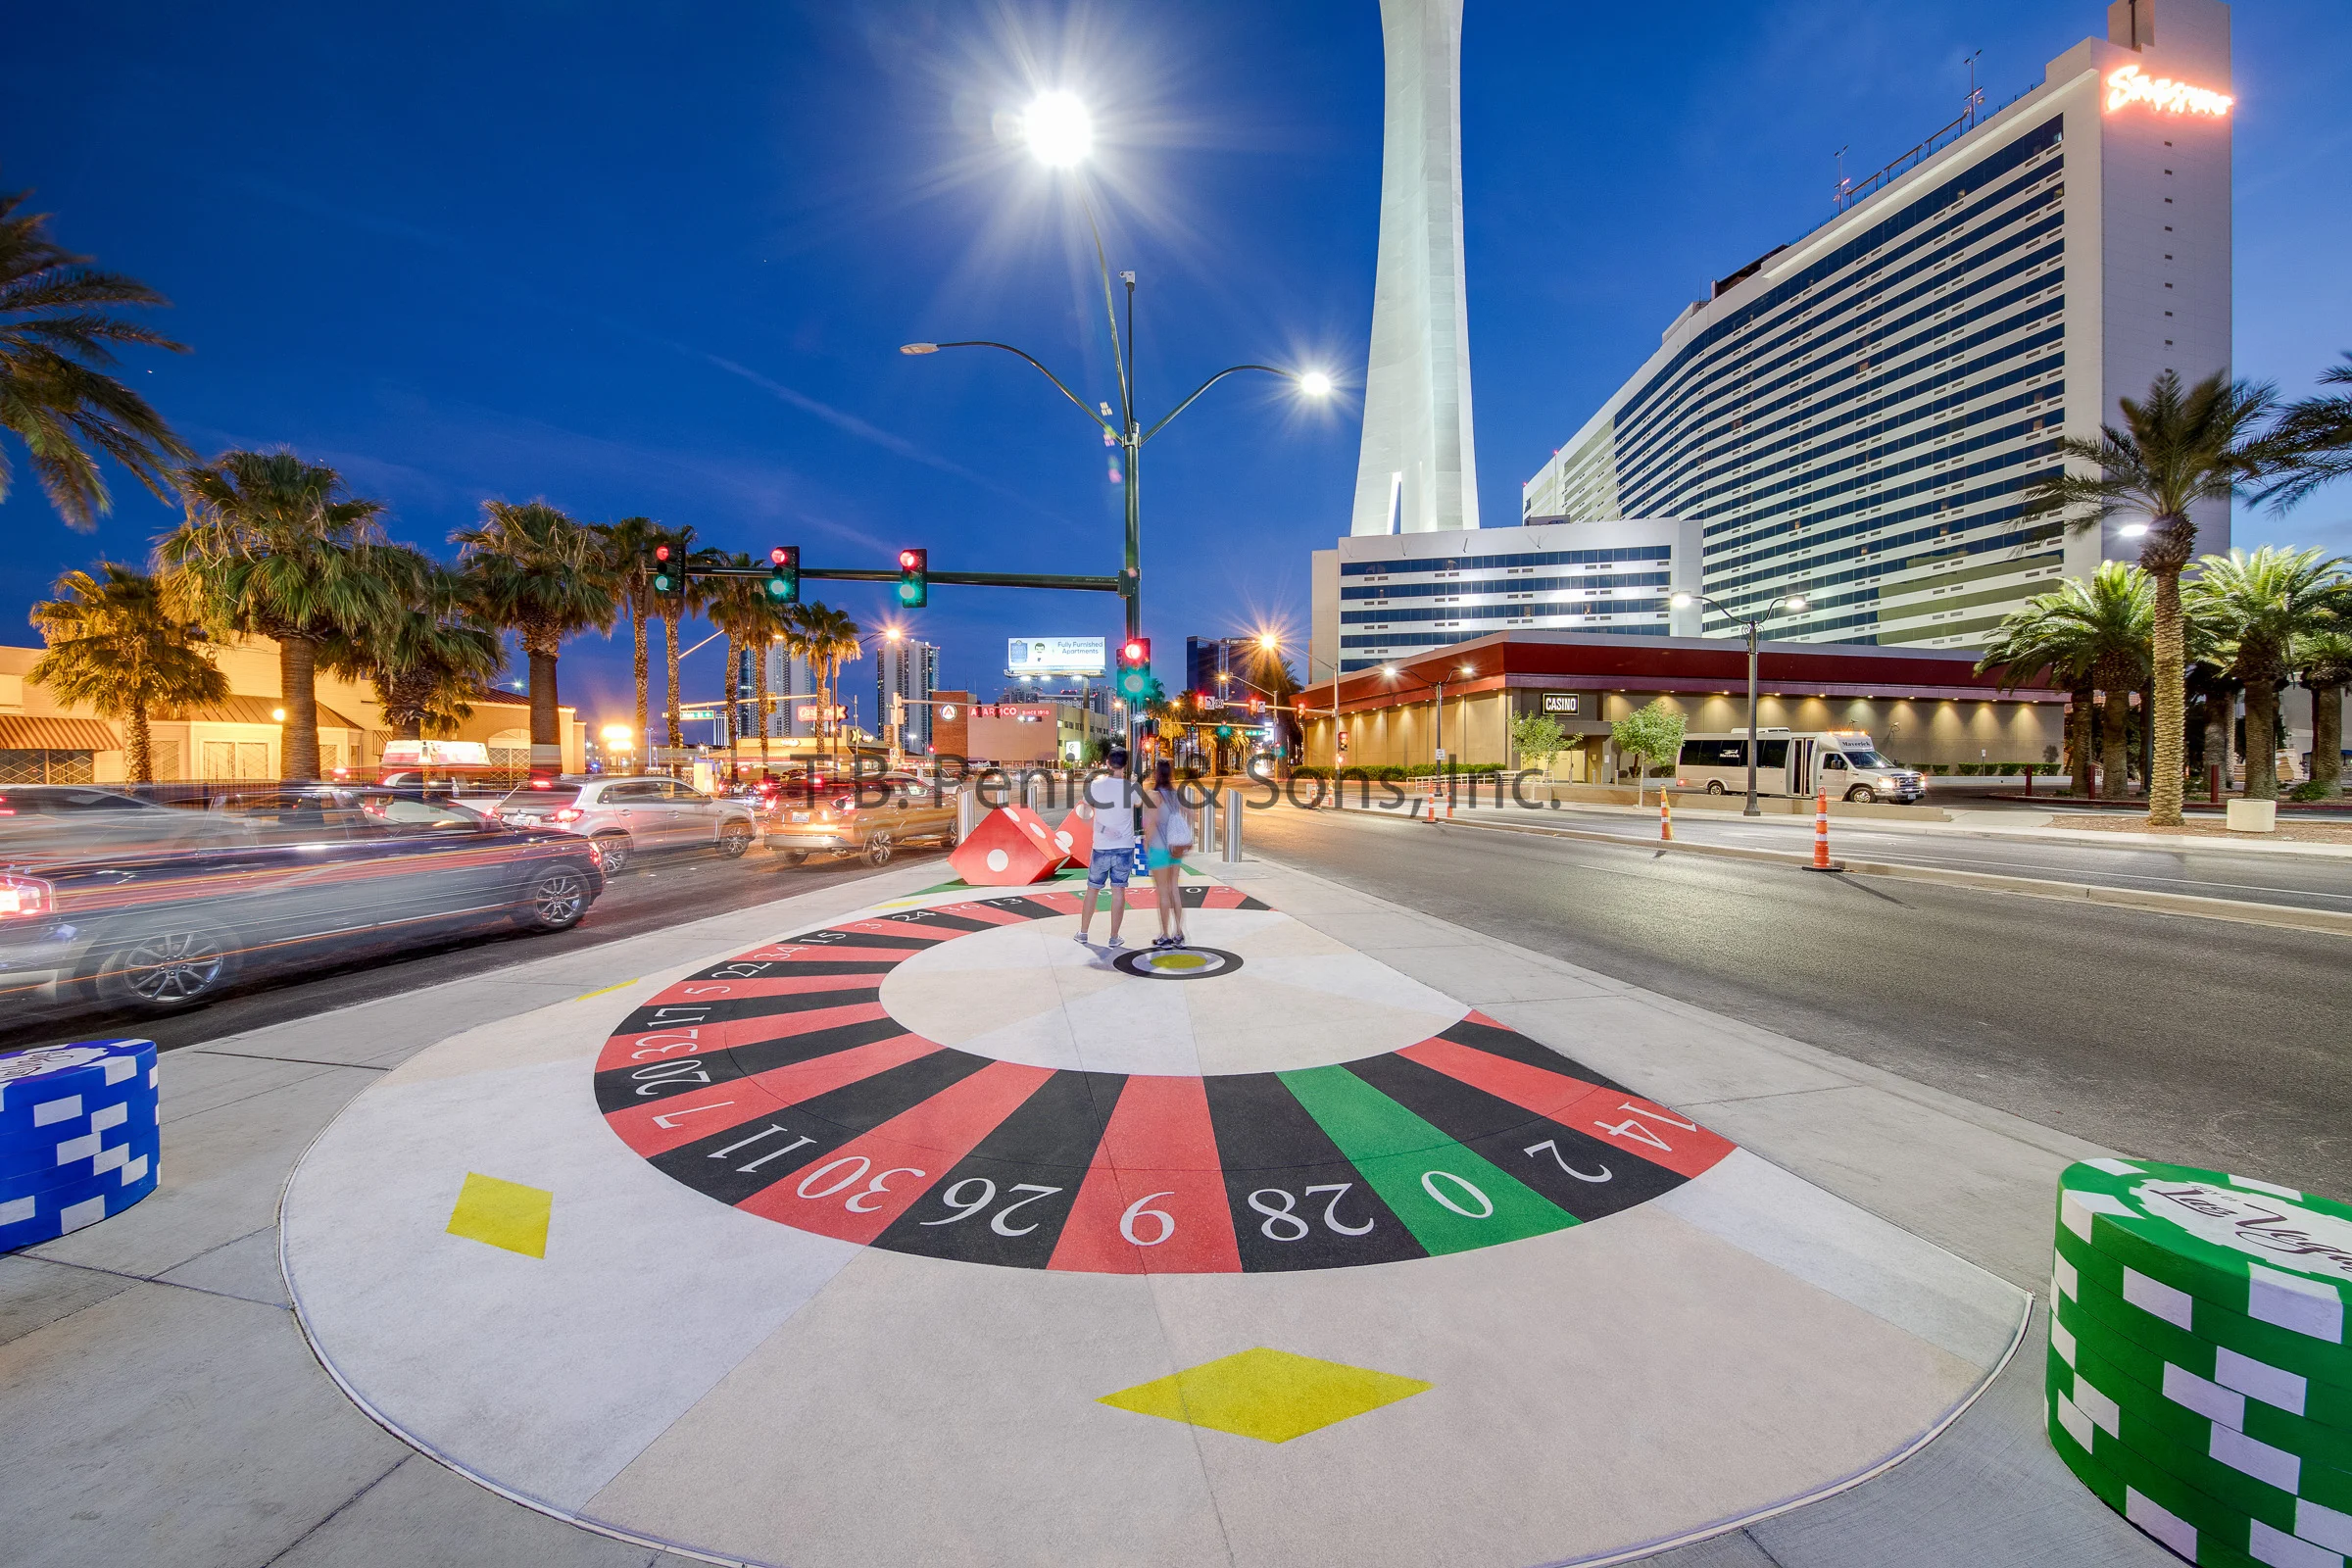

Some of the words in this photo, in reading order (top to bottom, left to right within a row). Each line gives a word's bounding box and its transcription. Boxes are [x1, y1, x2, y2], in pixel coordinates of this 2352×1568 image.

[970, 707, 1017, 716] AARCO
[1545, 698, 1577, 711] CASINO
[892, 908, 937, 922] 24
[939, 903, 980, 912] 36
[987, 898, 1023, 906] 13
[753, 944, 808, 959] 34
[799, 932, 847, 944] 15
[710, 961, 773, 979] 22
[683, 985, 731, 995] 5
[647, 1006, 711, 1027] 17
[630, 1029, 699, 1059] 32
[631, 1059, 711, 1096] 20
[652, 1101, 735, 1129] 7
[1593, 1102, 1698, 1152] 14
[707, 1123, 817, 1173] 11
[1523, 1139, 1613, 1184] 2
[796, 1155, 926, 1213] 30
[1421, 1170, 1494, 1219] 0
[919, 1177, 1063, 1237] 26
[1248, 1182, 1375, 1242] 28
[2148, 1189, 2239, 1218] Las
